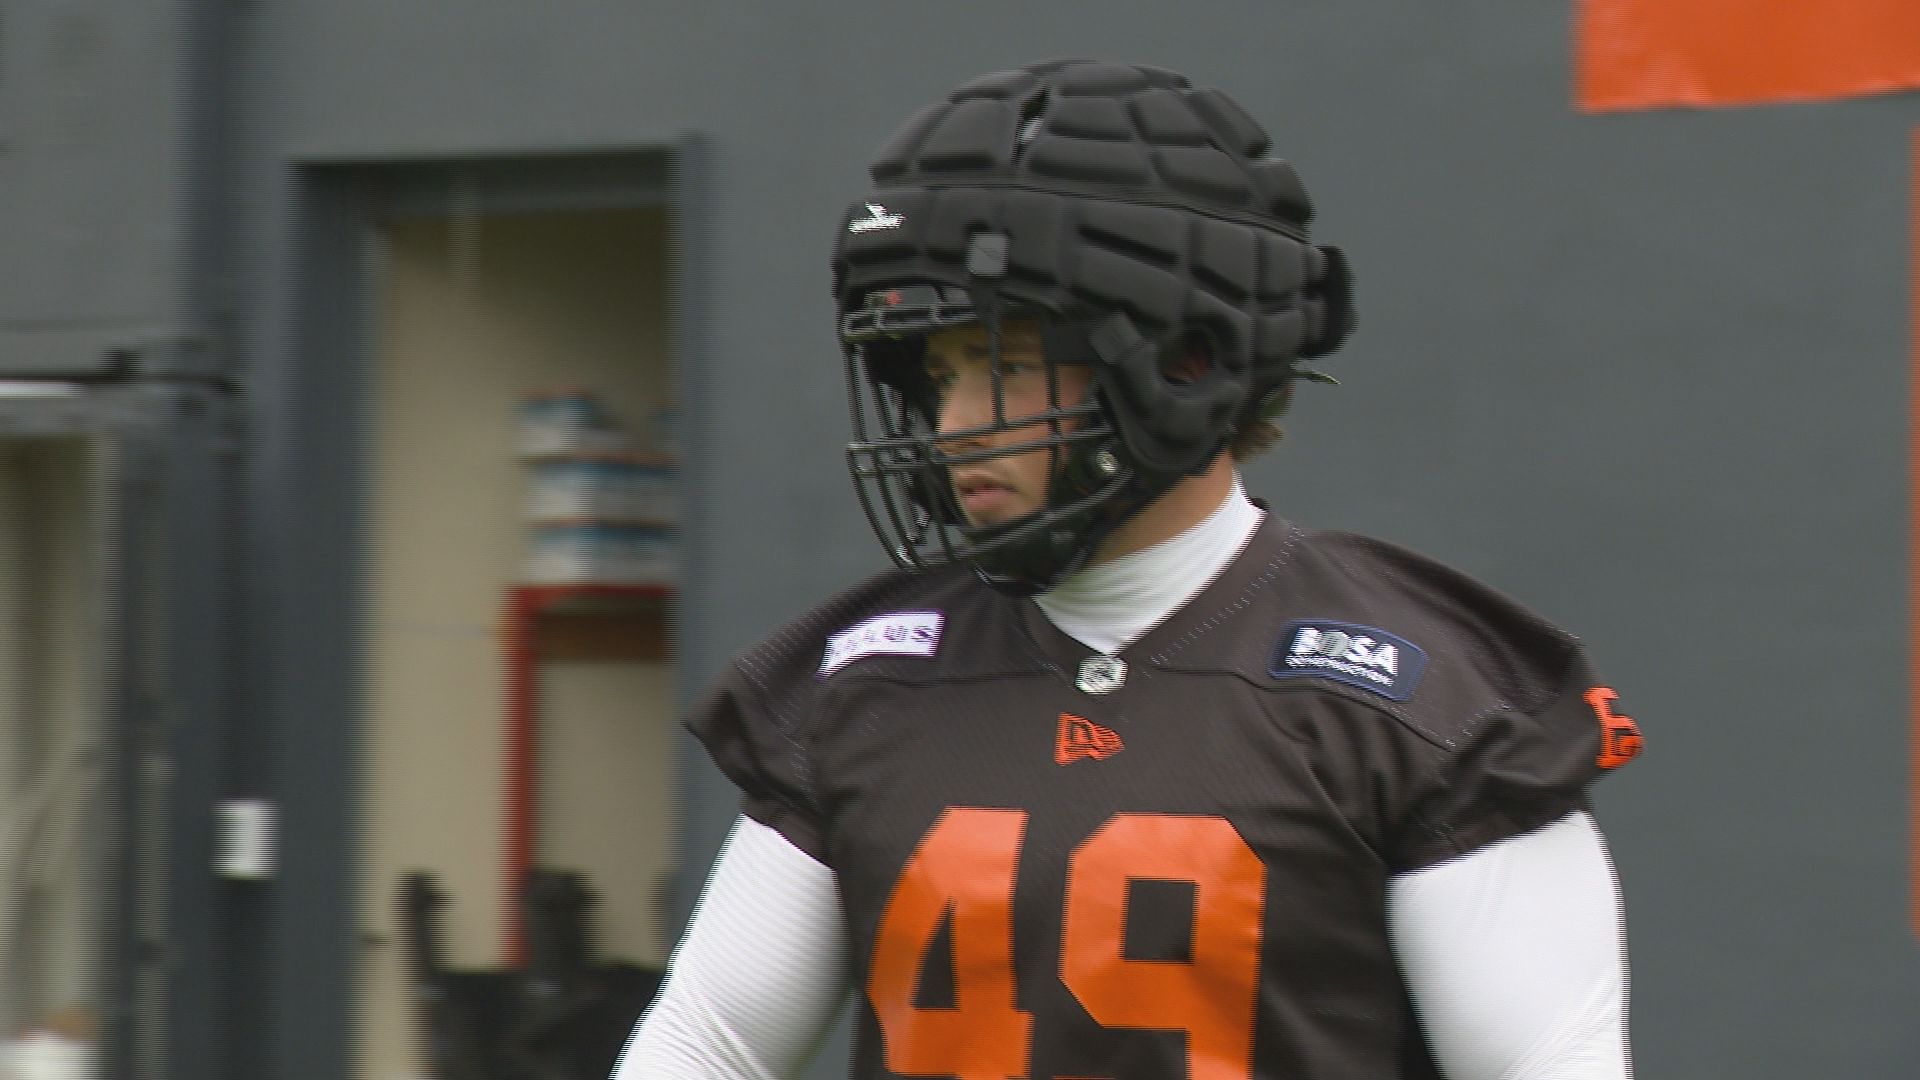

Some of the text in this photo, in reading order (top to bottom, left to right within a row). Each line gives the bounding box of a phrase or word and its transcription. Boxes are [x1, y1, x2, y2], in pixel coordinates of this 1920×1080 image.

[1284, 654, 1395, 686] CONSTRUCTION
[1290, 627, 1398, 676] BOSA
[867, 807, 1267, 1080] 49
